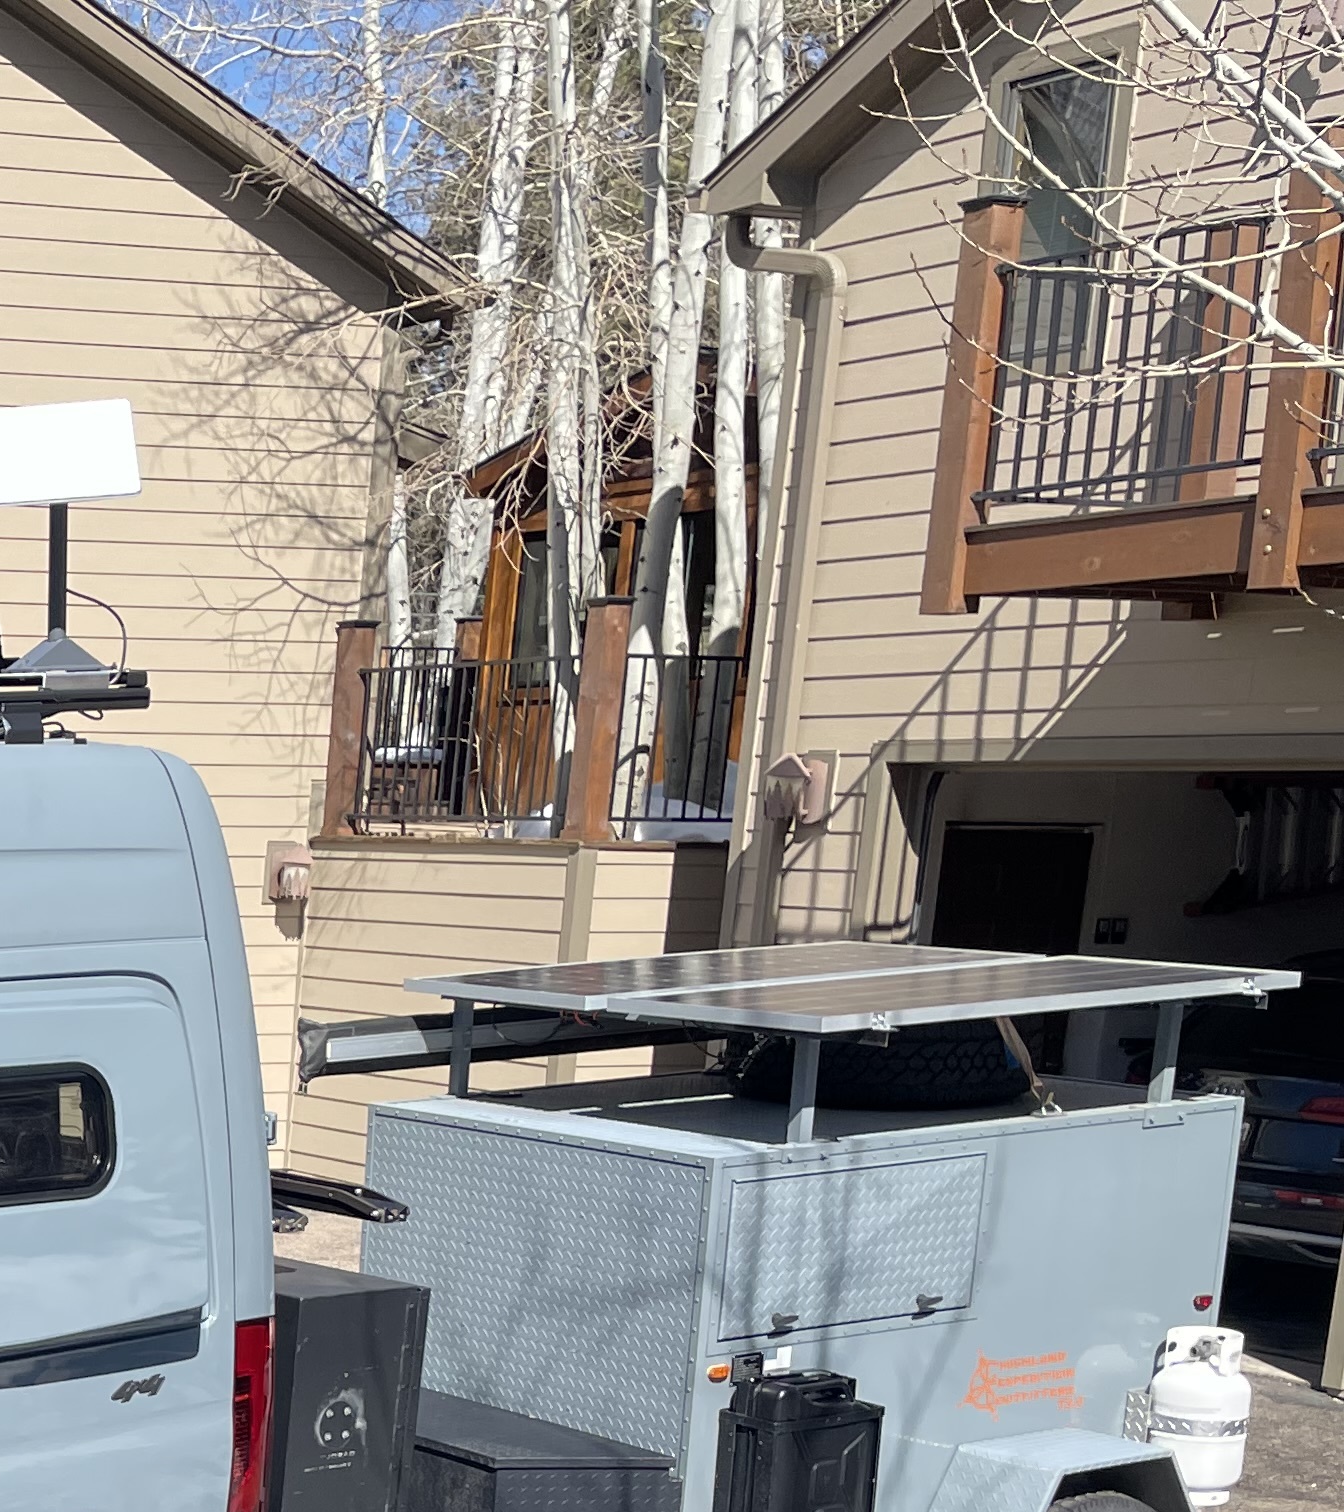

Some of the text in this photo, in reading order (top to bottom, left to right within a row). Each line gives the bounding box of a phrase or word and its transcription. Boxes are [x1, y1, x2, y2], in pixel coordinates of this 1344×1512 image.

[999, 1351, 1067, 1370] HIGHLAND
[997, 1368, 1075, 1387] EXPEDITION
[995, 1385, 1075, 1405] OUTFITTERS
